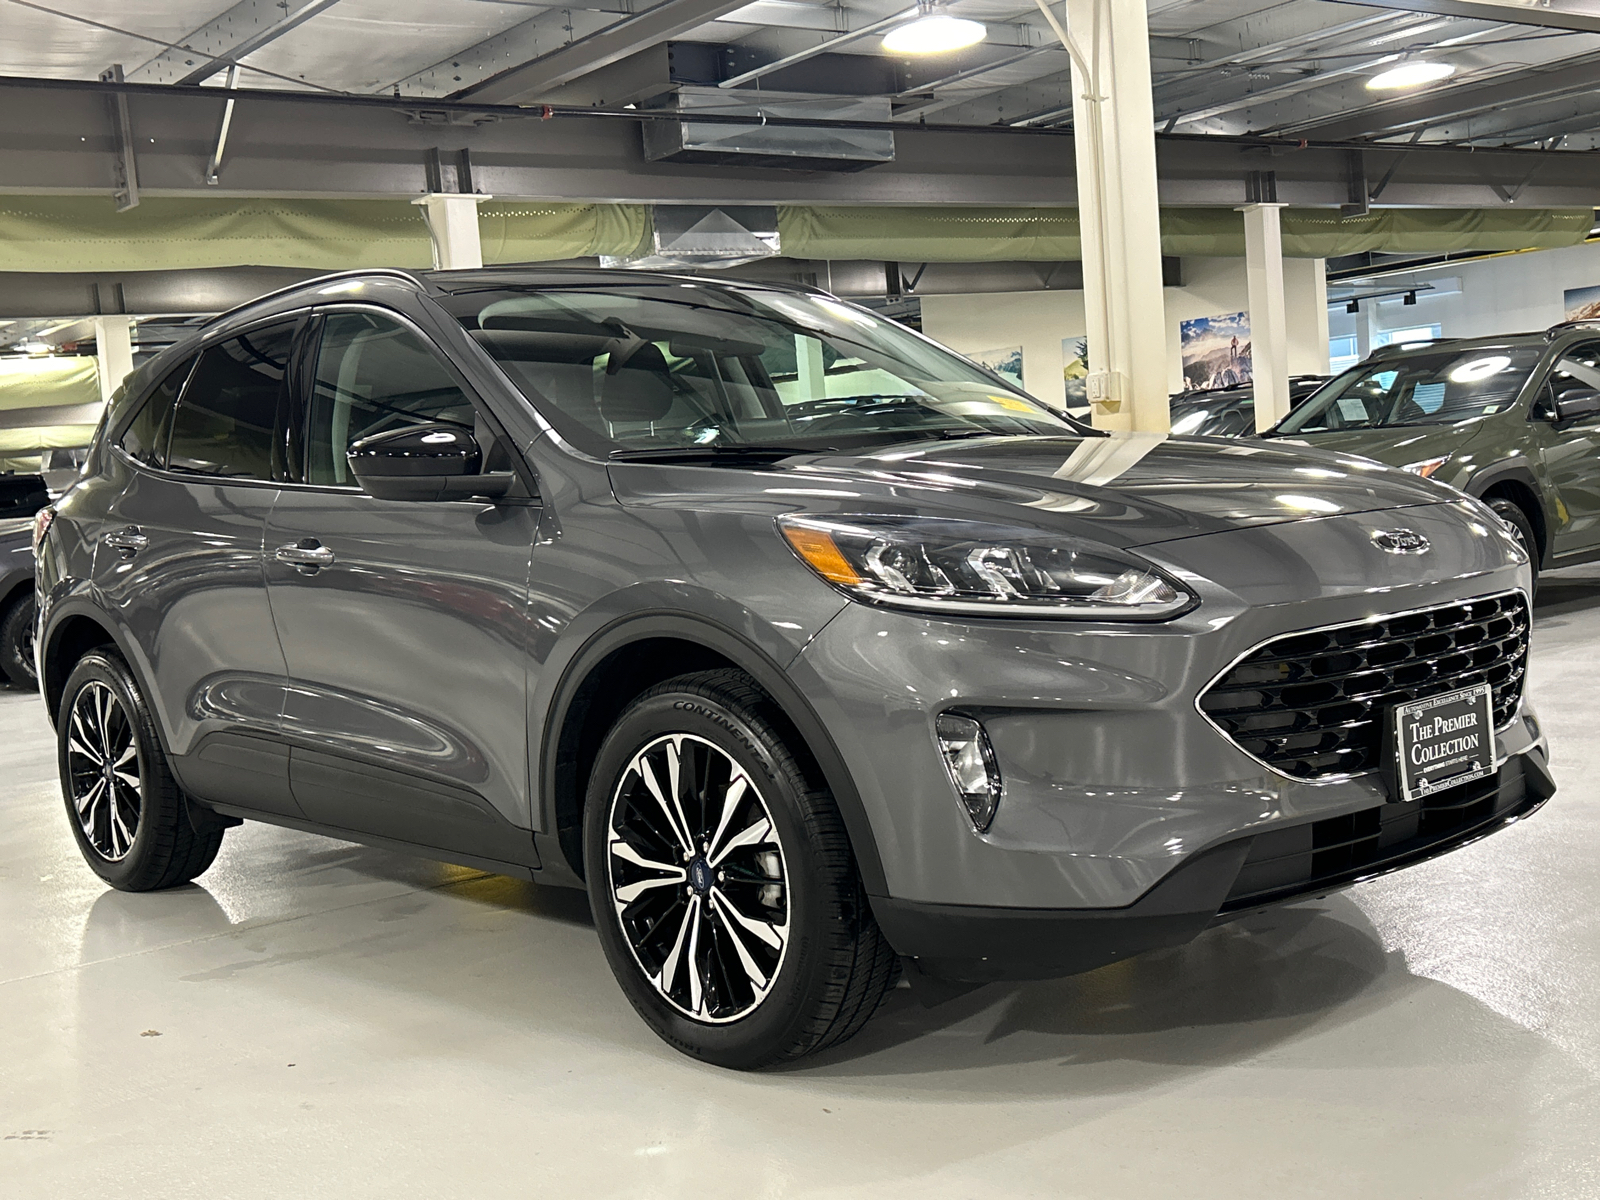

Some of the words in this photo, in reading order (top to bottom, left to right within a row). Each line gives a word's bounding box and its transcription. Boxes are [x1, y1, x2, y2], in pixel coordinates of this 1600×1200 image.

[1409, 722, 1433, 743] THE
[1433, 712, 1478, 736] PREMIER
[1411, 733, 1479, 765] COLLECTION
